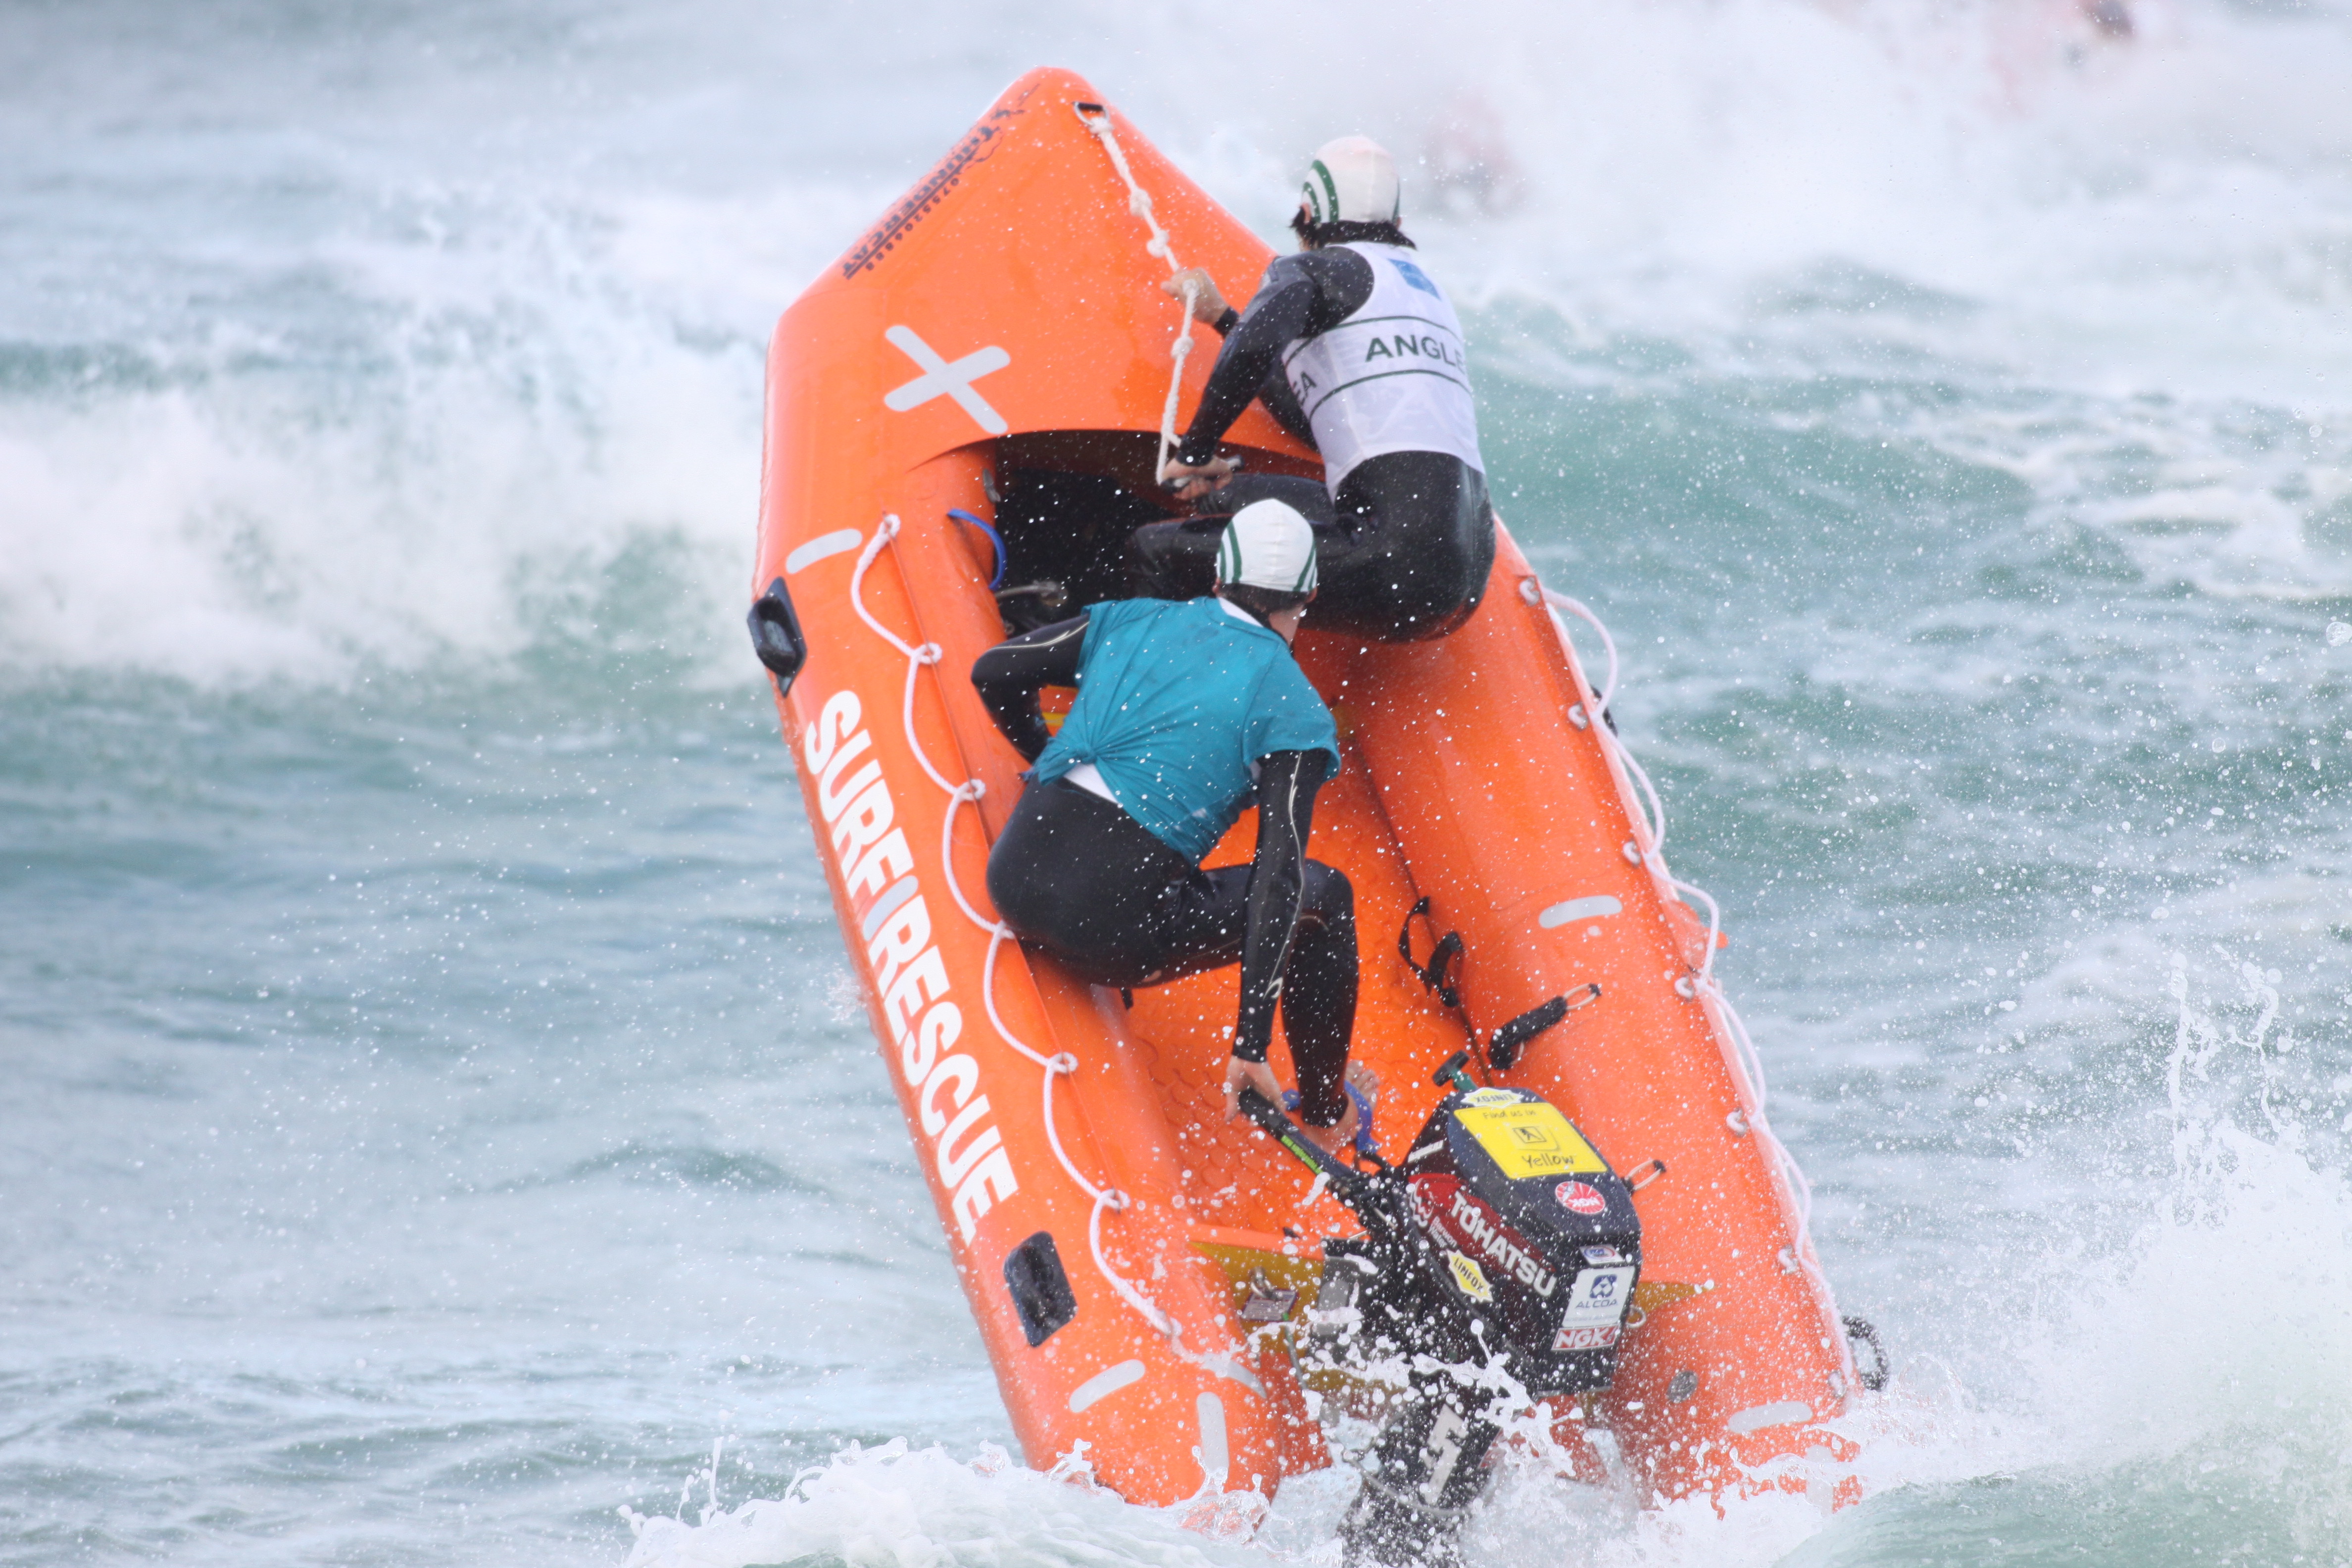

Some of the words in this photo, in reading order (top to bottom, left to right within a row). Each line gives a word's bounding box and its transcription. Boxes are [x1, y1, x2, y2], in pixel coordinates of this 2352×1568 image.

[1474, 1093, 1514, 1103] LINFOX
[1483, 1110, 1507, 1119] Find
[1521, 1153, 1574, 1168] Yellow
[1568, 1197, 1601, 1207] NGK
[1427, 1225, 1448, 1248] Water
[1432, 1216, 1458, 1247] Barwon
[1451, 1190, 1558, 1297] TOHATSU
[1454, 1258, 1484, 1291] LINFOX
[1575, 1298, 1618, 1308] ALCOA
[1555, 1327, 1611, 1348] NGK
